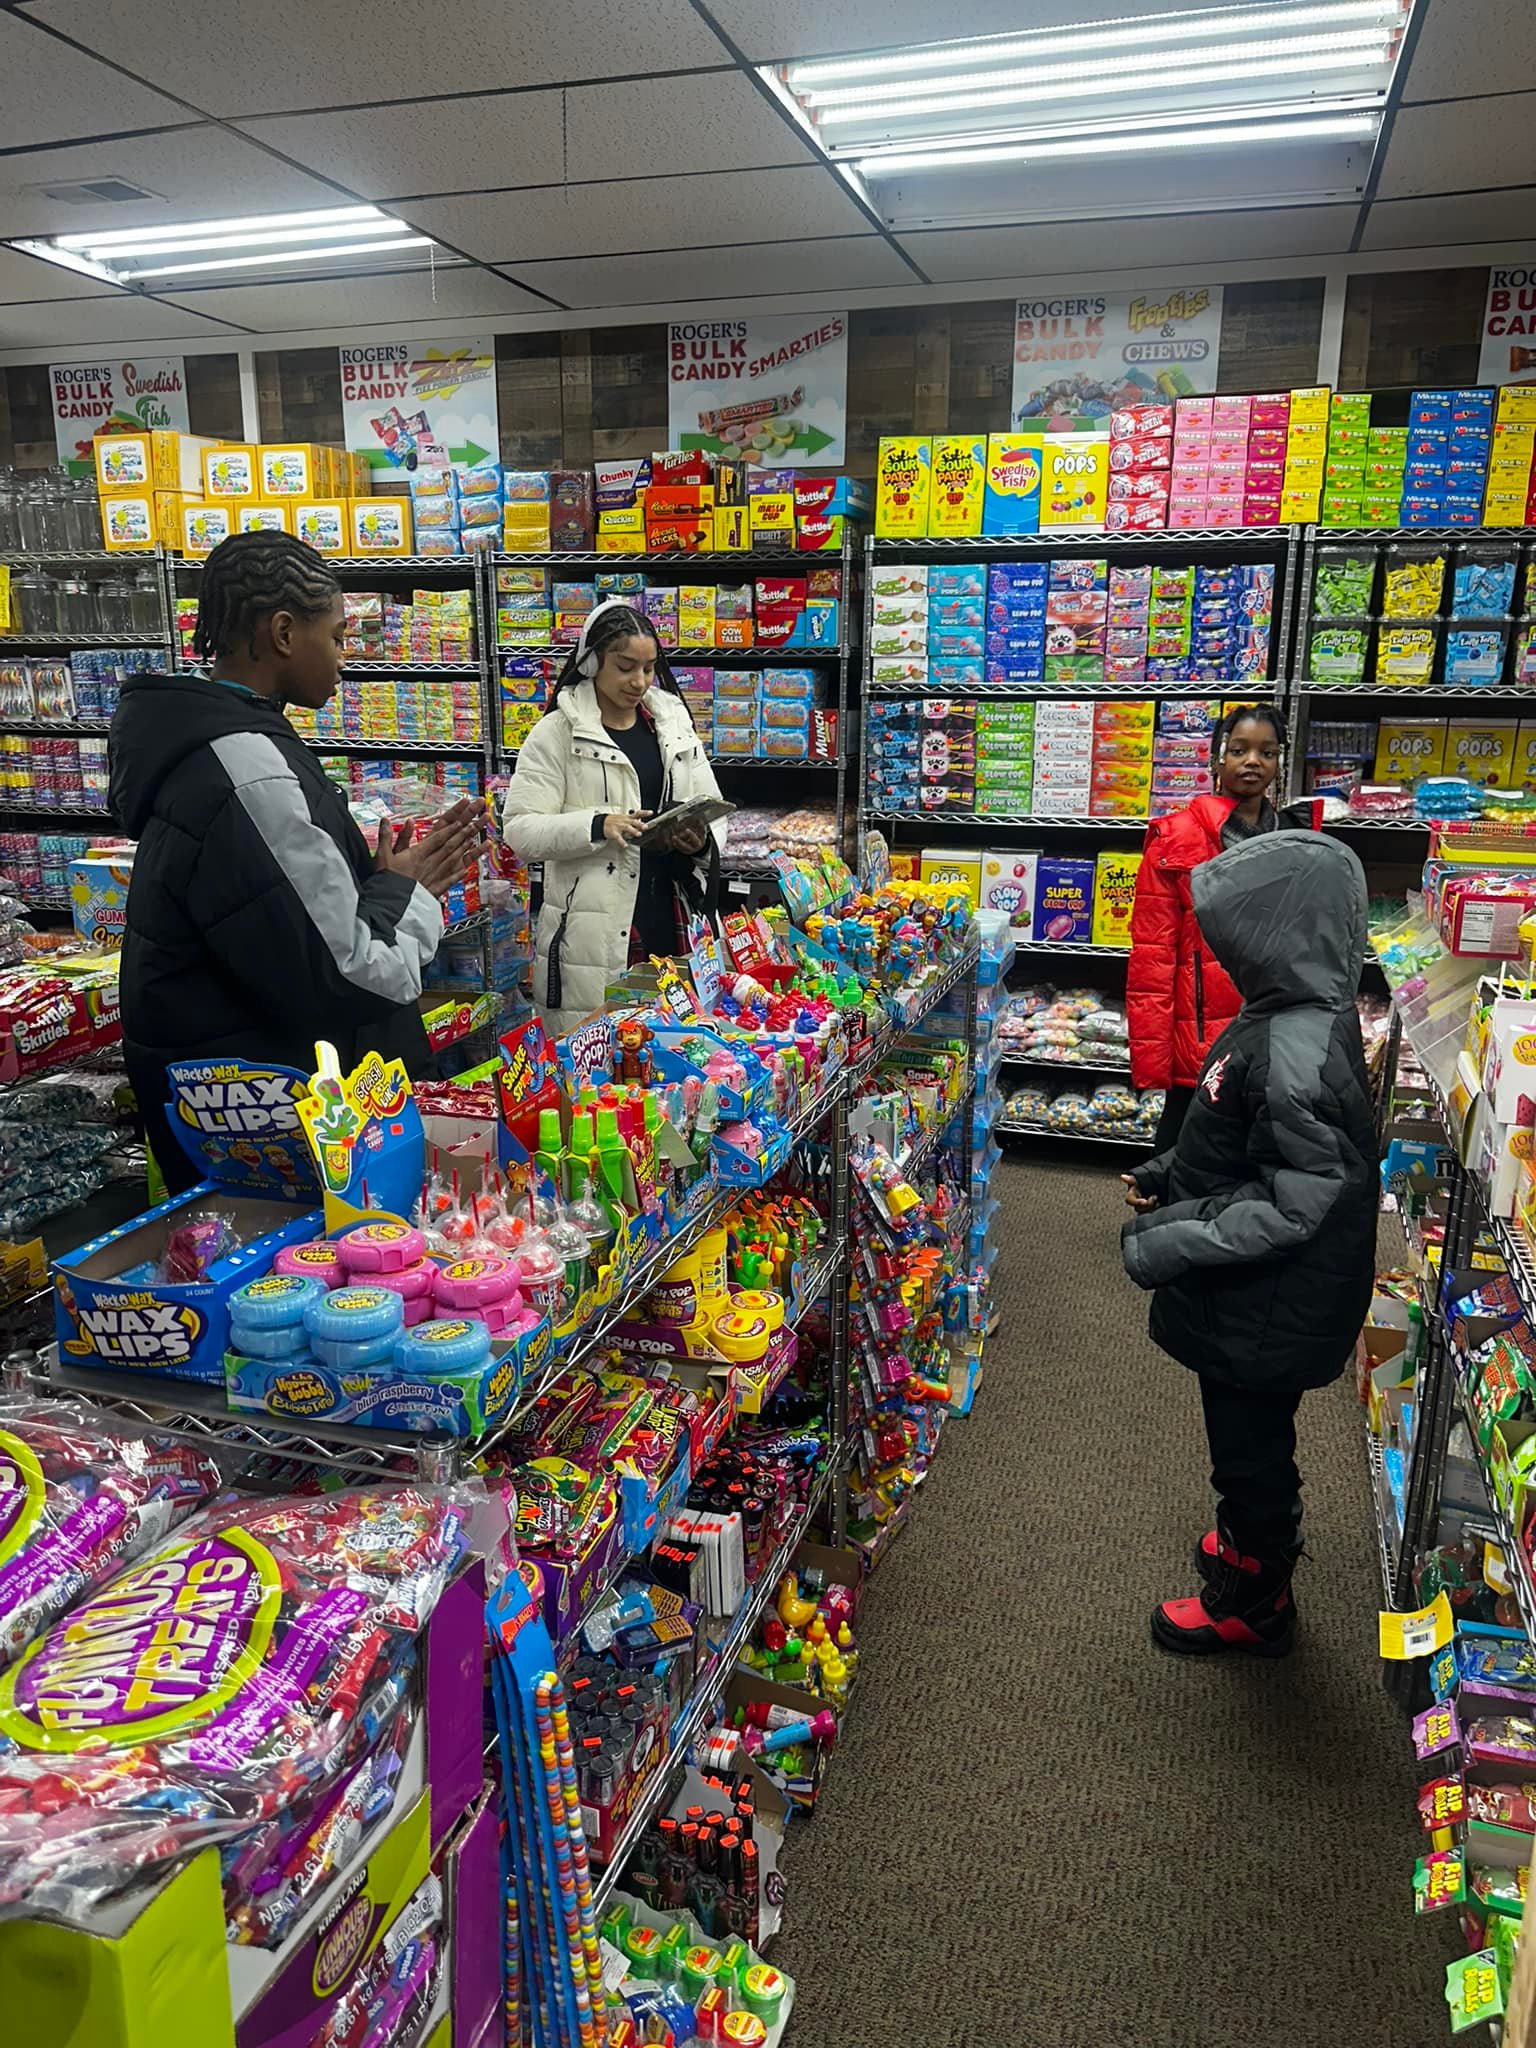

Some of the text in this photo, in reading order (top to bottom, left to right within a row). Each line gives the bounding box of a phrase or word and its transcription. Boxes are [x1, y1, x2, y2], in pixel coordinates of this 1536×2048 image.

[1018, 298, 1106, 319] ROGER'S
[670, 321, 747, 341] ROGER'S
[1017, 316, 1104, 341] BULK
[341, 345, 408, 363] ROGER'S
[671, 339, 747, 361] BULK
[749, 319, 844, 378] SMARTIES
[1016, 341, 1102, 362] CANDY
[1125, 341, 1206, 362] CHEWS
[54, 368, 111, 384] ROGER'S
[122, 362, 183, 397] Swedish
[343, 361, 409, 382] BULK
[671, 361, 746, 382] CANDY
[56, 383, 113, 400] BULK
[344, 382, 408, 401] CANDY
[58, 402, 113, 419] CANDY
[663, 451, 696, 471] Turtles
[885, 458, 917, 472] SOUR
[938, 458, 970, 472] SOUR
[1053, 456, 1097, 475] POPS
[600, 469, 634, 483] Chunky
[883, 471, 918, 483] PATCH
[938, 470, 973, 483] PATCH
[991, 463, 1037, 479] Swedish
[1001, 475, 1027, 488] Fish
[795, 491, 829, 505] Skittles
[758, 504, 786, 513] MALO
[762, 513, 779, 521] CUP
[801, 523, 832, 535] Skittles
[650, 534, 680, 547] STICKS
[758, 591, 790, 602] Skittles
[721, 634, 743, 643] TALES
[722, 628, 742, 636] COW
[758, 625, 790, 637] Skittles
[1391, 633, 1429, 645] Laffy Taffy
[1323, 634, 1358, 646] Laffy Taffy
[1460, 635, 1497, 647] Laffy Taffy
[1009, 714, 1024, 722] POP
[814, 710, 829, 757] MUNCH
[1008, 743, 1024, 751] POP
[1170, 750, 1196, 758] POPS
[1389, 738, 1434, 755] POPS
[1457, 740, 1503, 757] POPS
[1170, 779, 1196, 787] POPS
[1102, 877, 1135, 888] SOUR
[990, 885, 1022, 902] BLOW
[1046, 887, 1082, 898] SUPER
[997, 899, 1019, 911] POP
[1043, 899, 1085, 909] BLOW POP
[20, 1024, 70, 1054] Skittles
[573, 1024, 610, 1062] SQUEEZY
[502, 1044, 526, 1090] SNAKE
[357, 1061, 383, 1098] SPLASH
[177, 1078, 295, 1109] WAX
[197, 1105, 300, 1132] LIPS
[194, 1288, 214, 1296] COUNT
[669, 1286, 692, 1299] POP
[79, 1306, 184, 1333] WAX
[94, 1332, 190, 1357] LIPS
[638, 1339, 675, 1354] POP
[169, 1355, 191, 1365] LATER
[356, 1382, 433, 1412] blue raspberry
[385, 1402, 397, 1415] 6
[47, 1593, 62, 1612] kg
[111, 1541, 124, 1556] 92
[123, 1521, 139, 1544] OZ
[123, 1556, 247, 1711] TREATS
[208, 1618, 239, 1694] ASSORTED
[296, 1654, 311, 1672] ALL
[317, 1870, 367, 1936] KIRKLAND
[317, 1899, 370, 1978] FUNHOUSE
